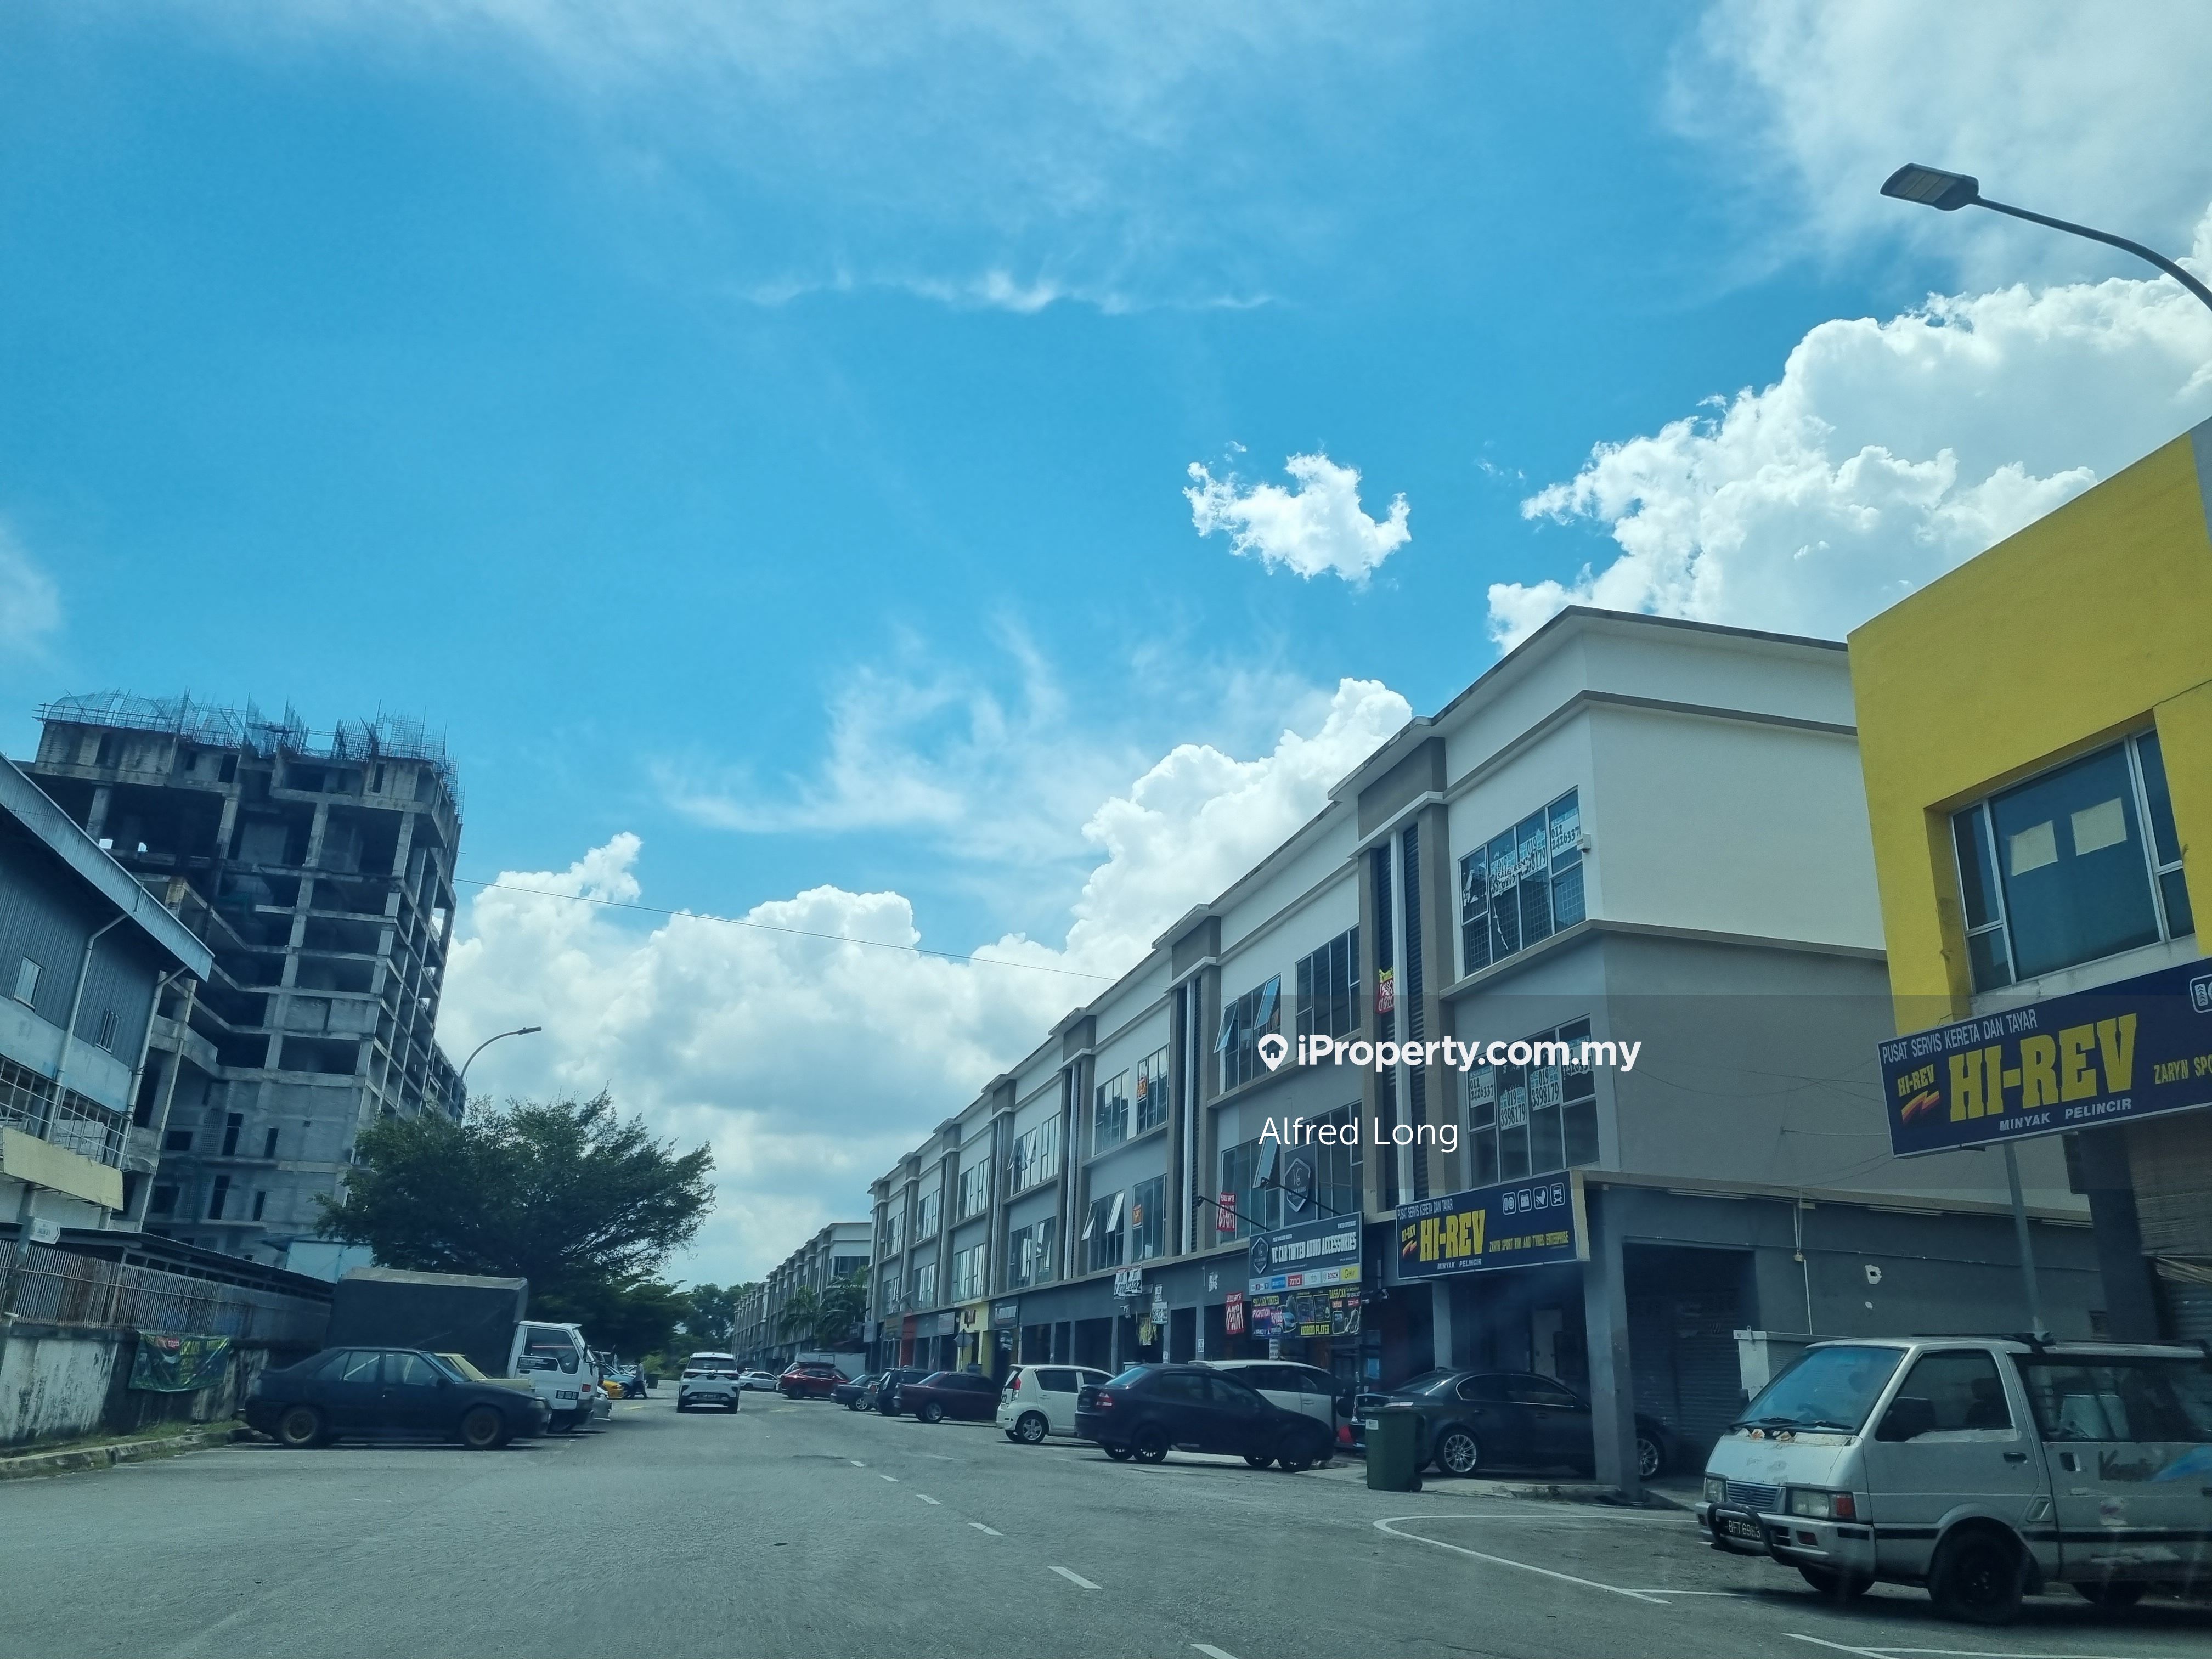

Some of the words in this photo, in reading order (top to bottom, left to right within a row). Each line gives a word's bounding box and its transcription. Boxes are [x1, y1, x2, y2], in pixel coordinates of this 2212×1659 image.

[1551, 824, 1562, 839] 012
[1552, 826, 1579, 850] 2426337
[1882, 1042, 1908, 1064] PUSAT
[1911, 1033, 1942, 1057] SERVIS
[1945, 1024, 1980, 1049] KERETA
[1983, 1017, 2004, 1040] DAN
[2006, 1009, 2038, 1033] TAYAR
[1538, 1068, 1549, 1086] 019
[1949, 1013, 2137, 1122] HI-REV
[2154, 1059, 2189, 1085] ZARYN
[1470, 1077, 1480, 1090] 012
[1471, 1084, 1494, 1101] 2426337
[1897, 1064, 1934, 1097] HI-REV
[1507, 1090, 1516, 1107] 019
[1532, 1081, 1559, 1107] 3398179
[1500, 1103, 1526, 1127] 3398179
[2000, 1112, 2050, 1131] MINYAK
[2065, 1098, 2131, 1120] PELINCIR
[1397, 1207, 1407, 1220] PUSAT
[1408, 1205, 1419, 1218] SERVIS
[1420, 1202, 1432, 1216] KERETA
[1322, 1231, 1357, 1255] ACCESSORIES
[1402, 1223, 1415, 1242] HI-REV
[1420, 1209, 1486, 1262] HI-REV
[1437, 1262, 1455, 1270] MINYAK
[1459, 1258, 1482, 1267] PELINCIR
